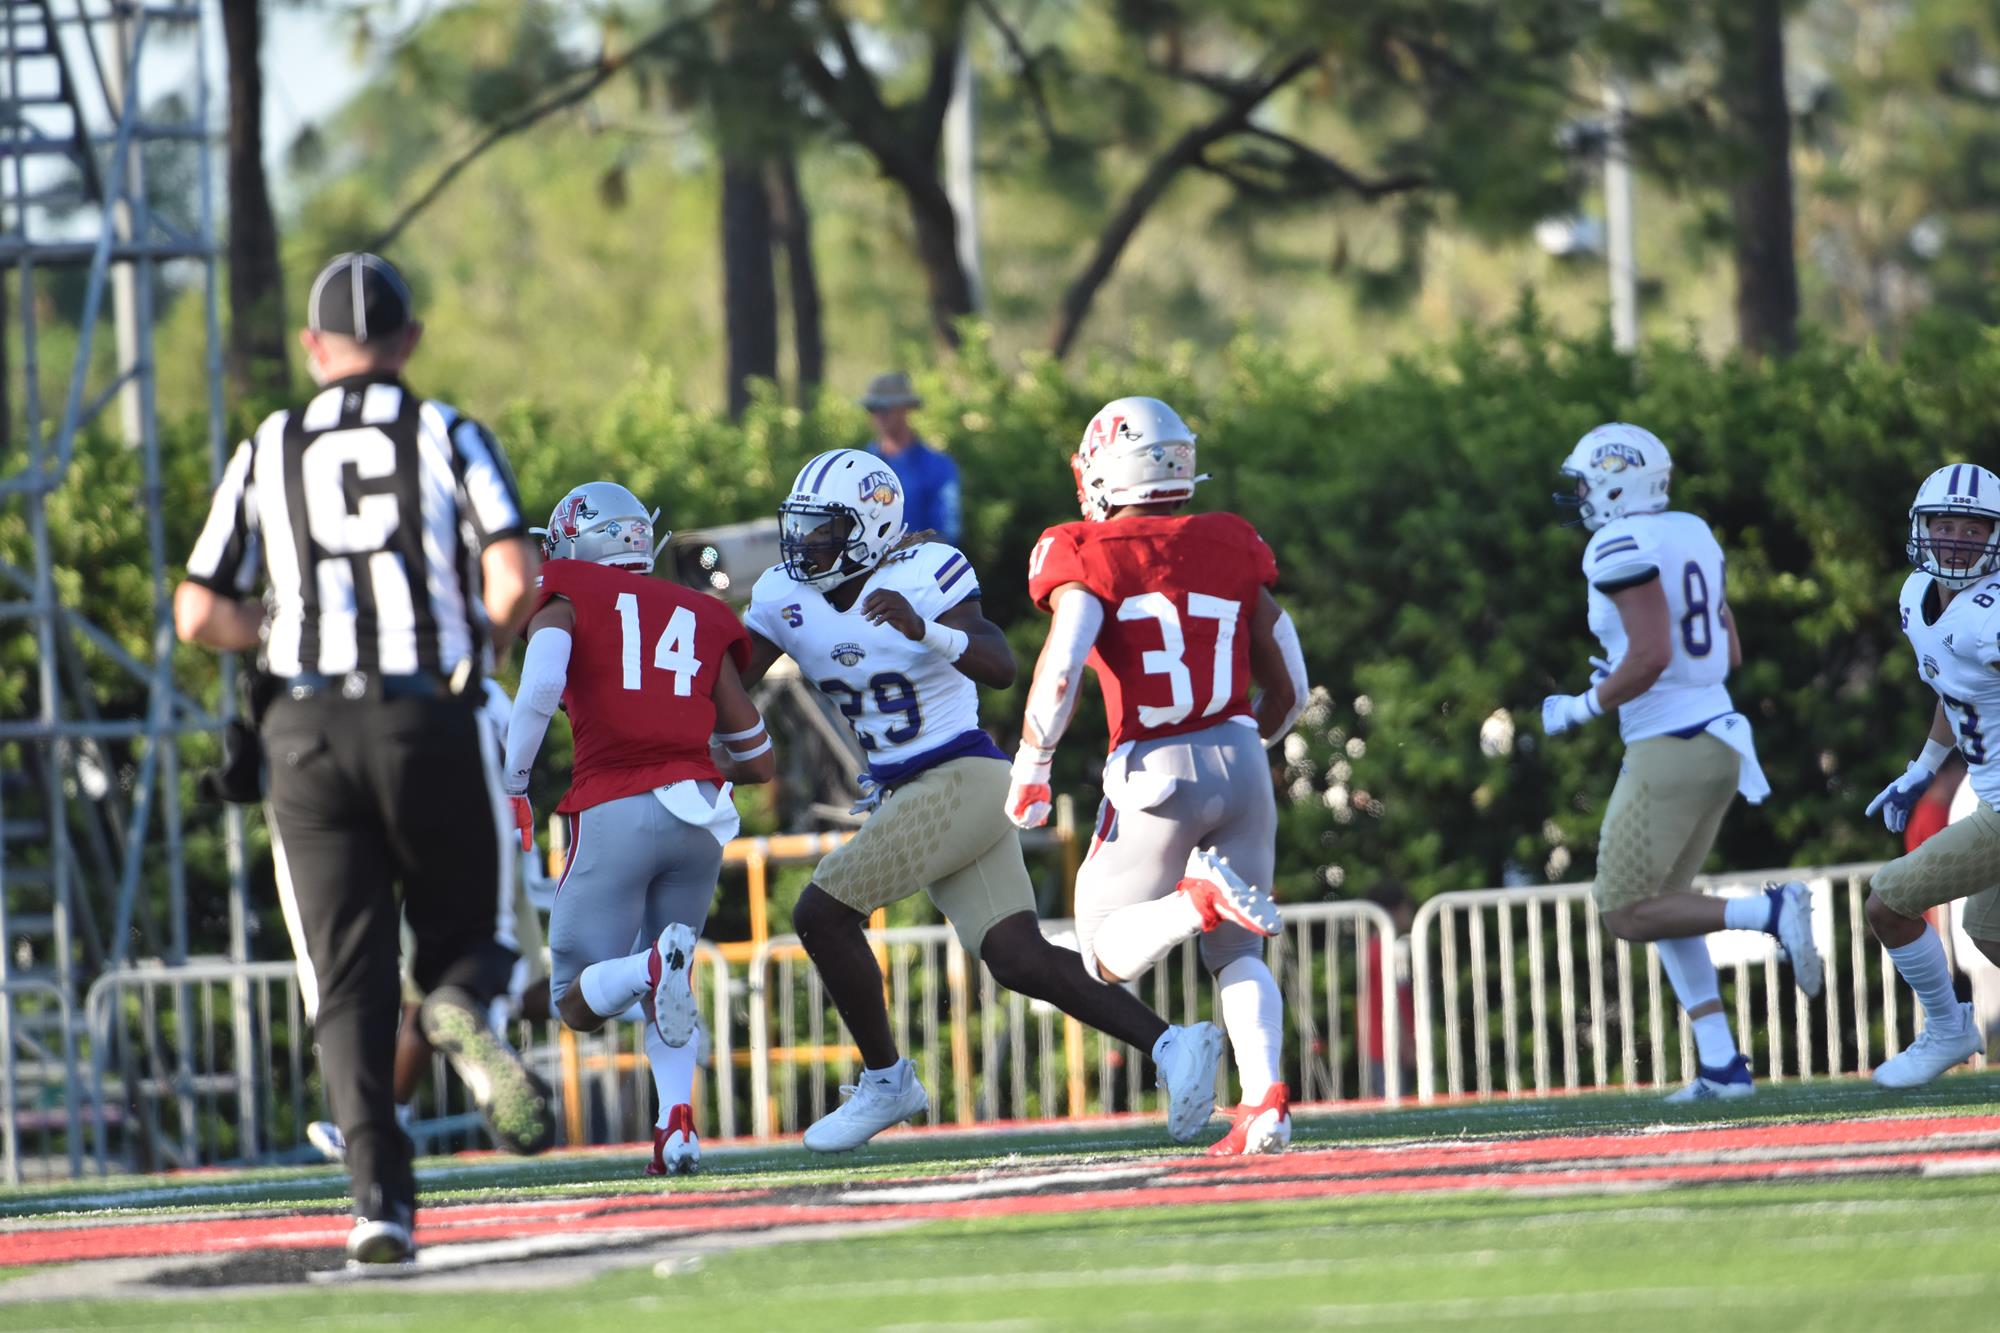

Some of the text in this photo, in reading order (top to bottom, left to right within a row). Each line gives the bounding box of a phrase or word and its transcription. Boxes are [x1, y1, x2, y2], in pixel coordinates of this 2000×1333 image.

[302, 427, 399, 552] C
[550, 494, 587, 544] N
[615, 593, 702, 696] 14
[1117, 592, 1241, 728] 37
[820, 673, 923, 750] 29
